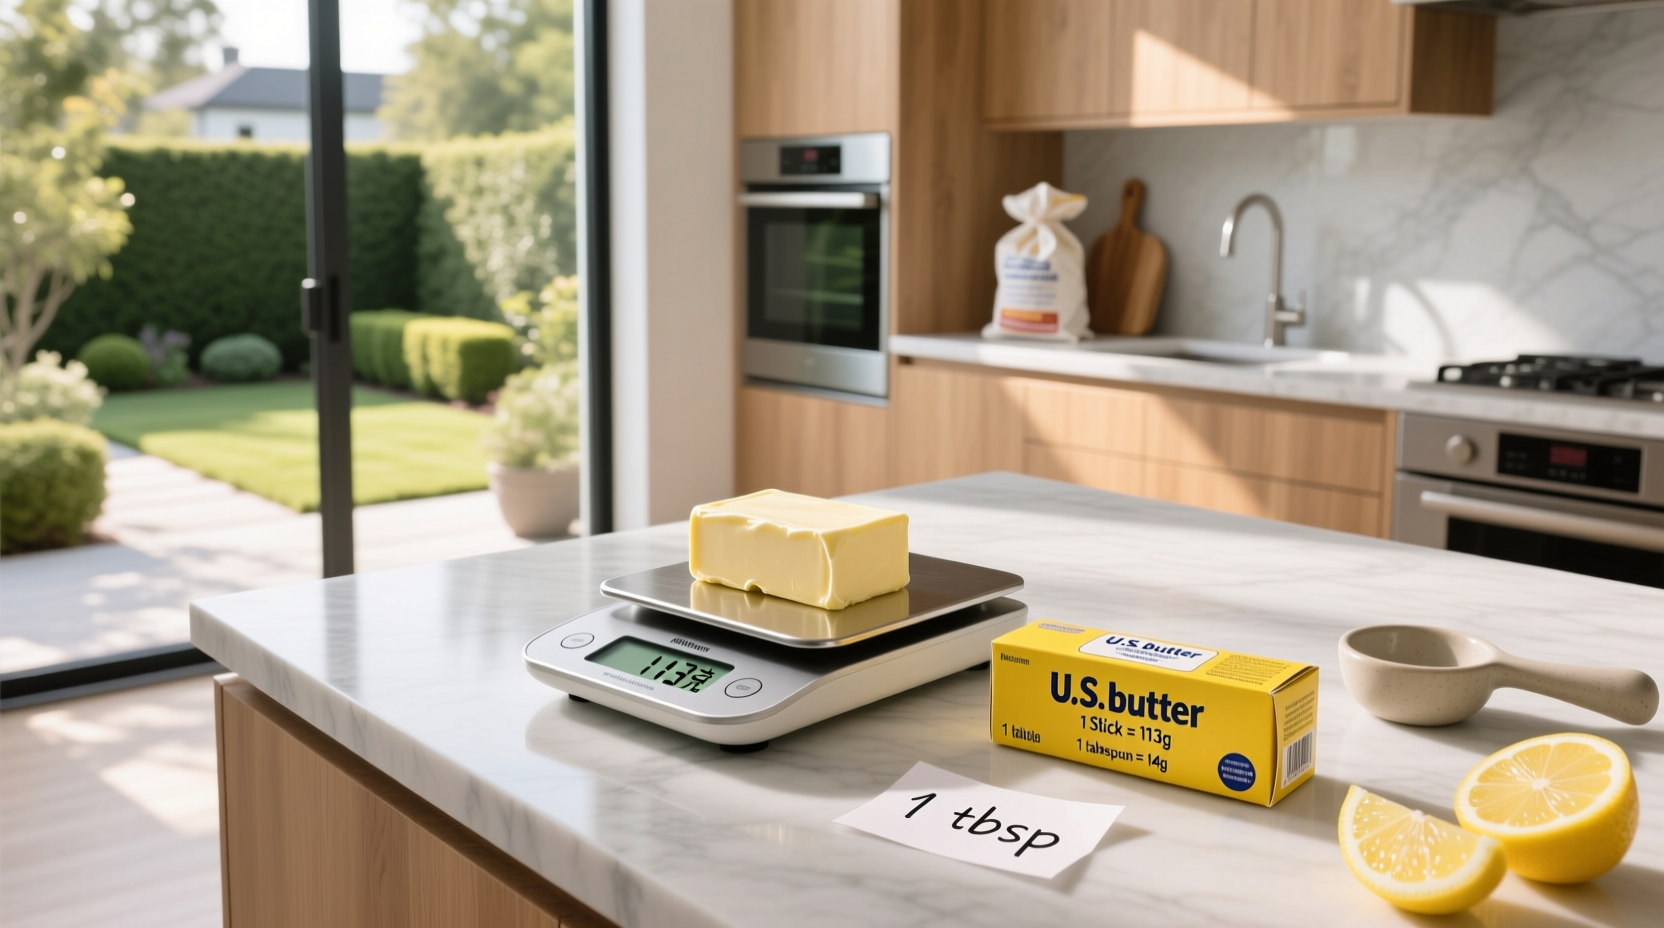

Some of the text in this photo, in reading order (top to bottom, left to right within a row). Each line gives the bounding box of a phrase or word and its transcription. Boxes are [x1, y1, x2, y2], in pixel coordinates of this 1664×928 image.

[1002, 723, 1007, 736] 1
[1081, 715, 1086, 729] 1
[1090, 716, 1123, 737] Stick
[1140, 726, 1171, 750] 113g
[1077, 738, 1082, 751] 1
[1148, 753, 1168, 773] 14g
[904, 792, 1060, 858] 1 tbsp
